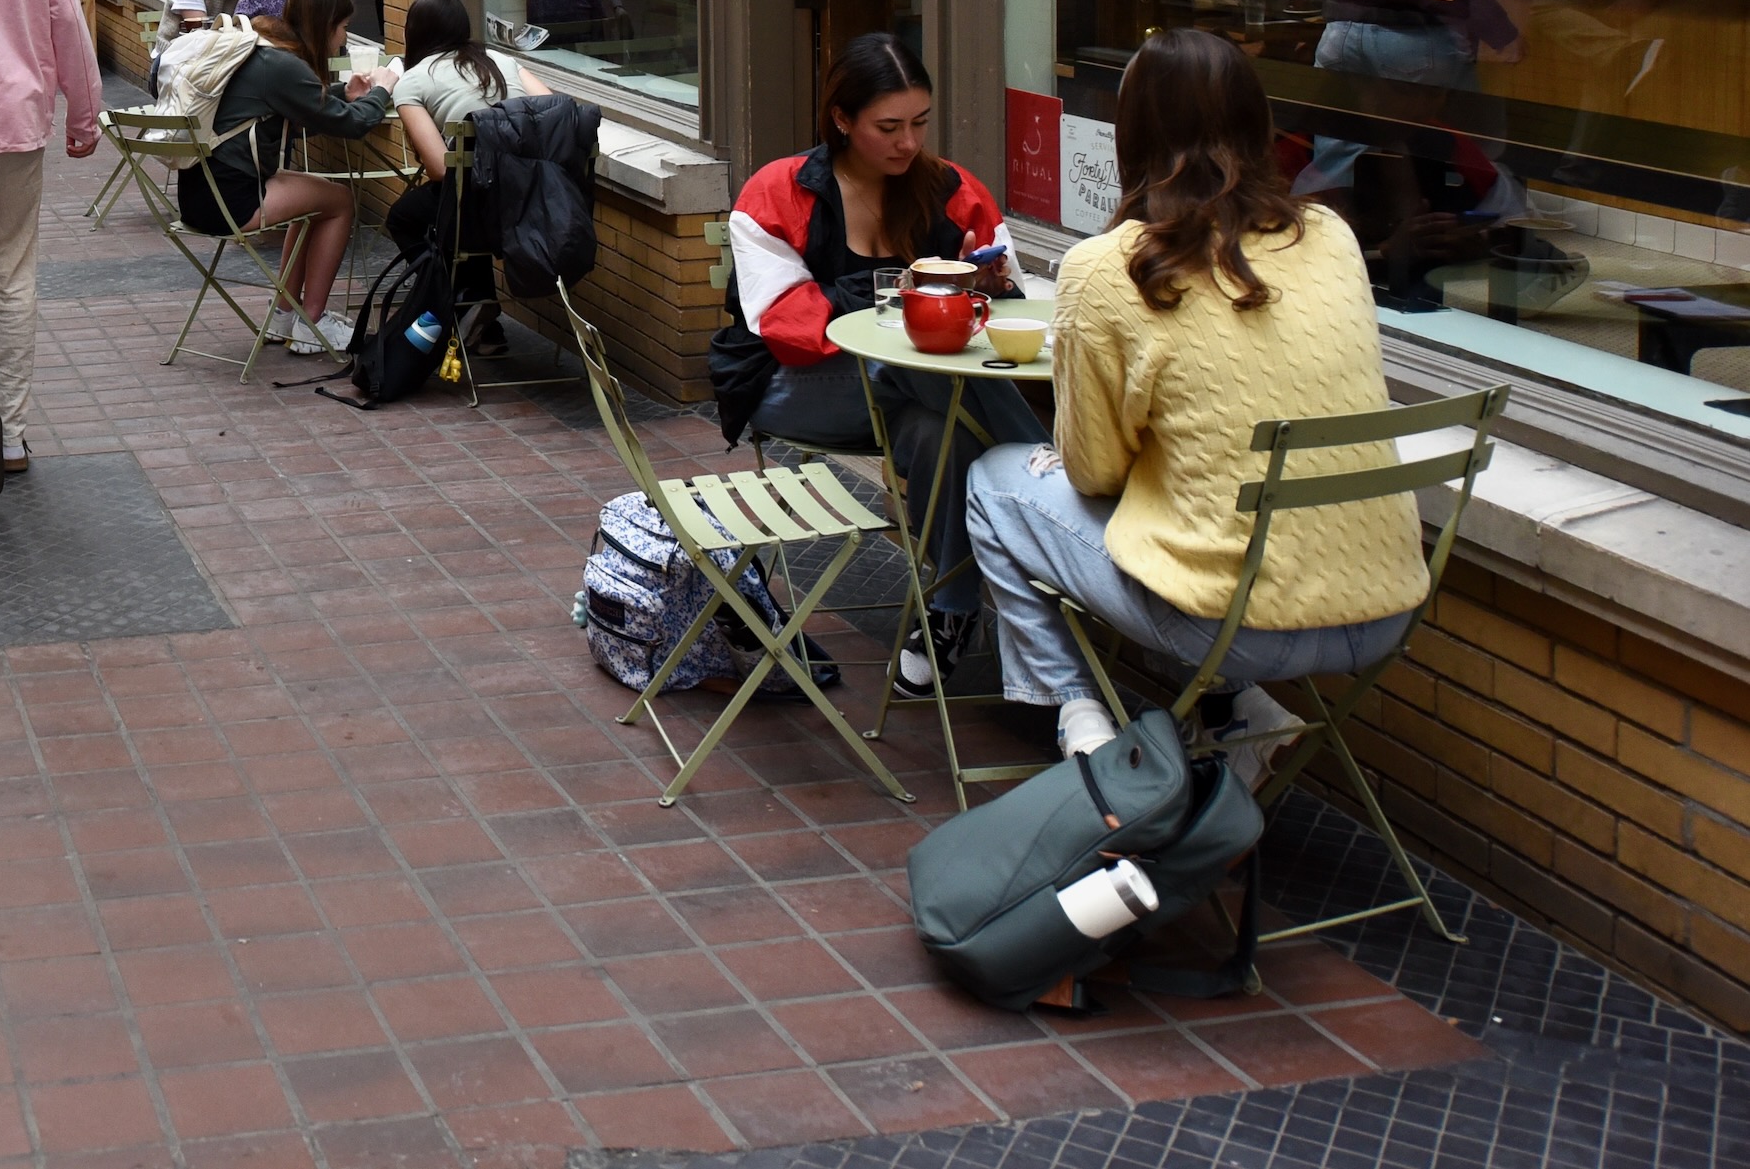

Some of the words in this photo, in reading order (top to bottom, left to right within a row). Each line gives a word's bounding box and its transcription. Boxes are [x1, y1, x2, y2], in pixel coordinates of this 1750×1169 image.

[1012, 159, 1052, 182] RITUAL
[1069, 152, 1106, 190] Forty
[1075, 209, 1101, 223] COFFEE
